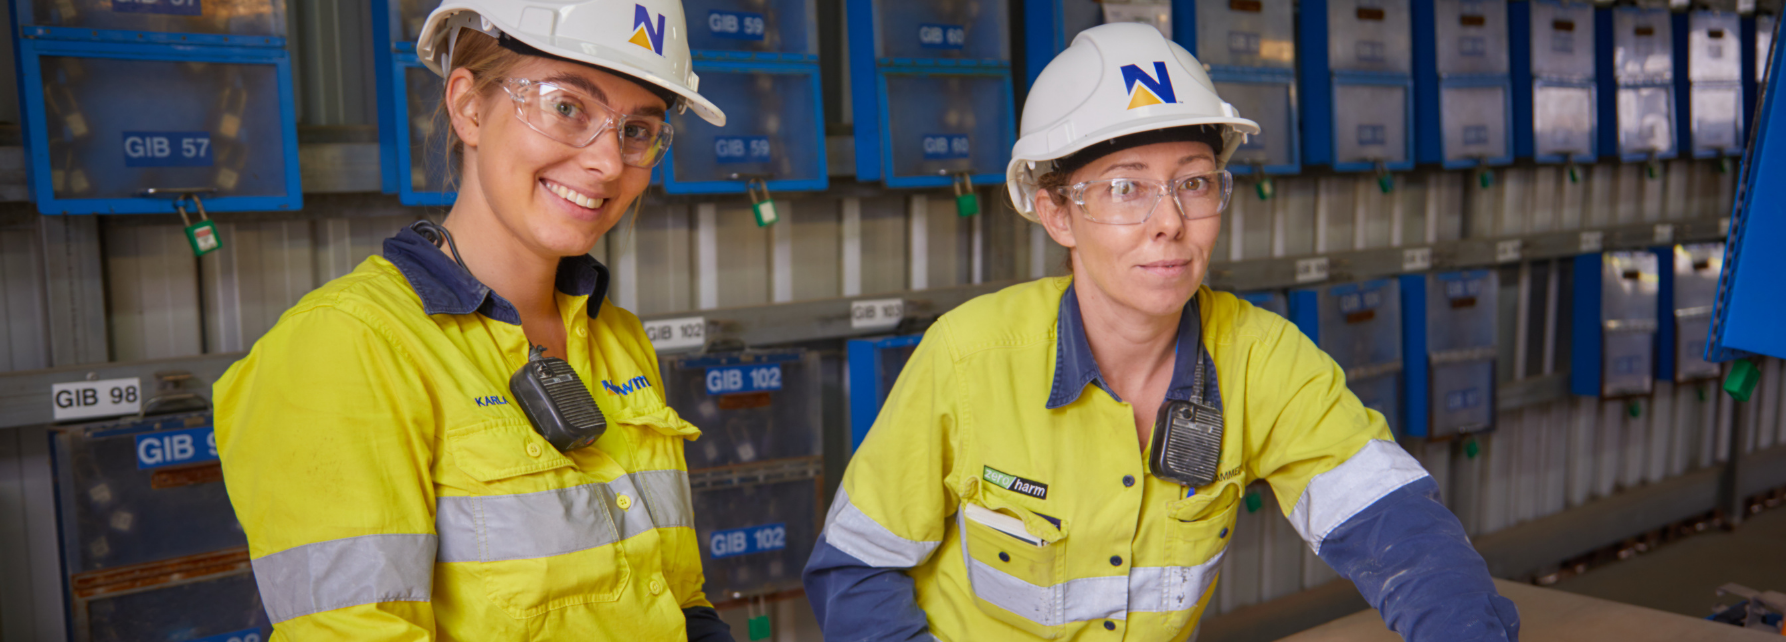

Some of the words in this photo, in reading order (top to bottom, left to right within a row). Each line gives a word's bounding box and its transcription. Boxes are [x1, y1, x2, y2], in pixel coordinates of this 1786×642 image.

[709, 13, 739, 32] GIB
[744, 17, 764, 35] 59
[919, 26, 943, 44] GIB
[125, 136, 171, 158] GIB
[181, 138, 210, 158] 57
[715, 139, 745, 157] GIB
[750, 139, 770, 157] 59
[924, 137, 948, 153] GIB
[853, 304, 876, 320] GIB
[881, 304, 903, 318] 103
[646, 325, 672, 341] GIB
[680, 322, 702, 338] 102
[706, 368, 743, 392] GIB
[749, 366, 781, 389] 102
[56, 388, 98, 409] GIB
[110, 385, 137, 405] 98
[138, 433, 195, 465] GIB
[711, 530, 747, 556] GIB
[754, 526, 785, 550] 102
